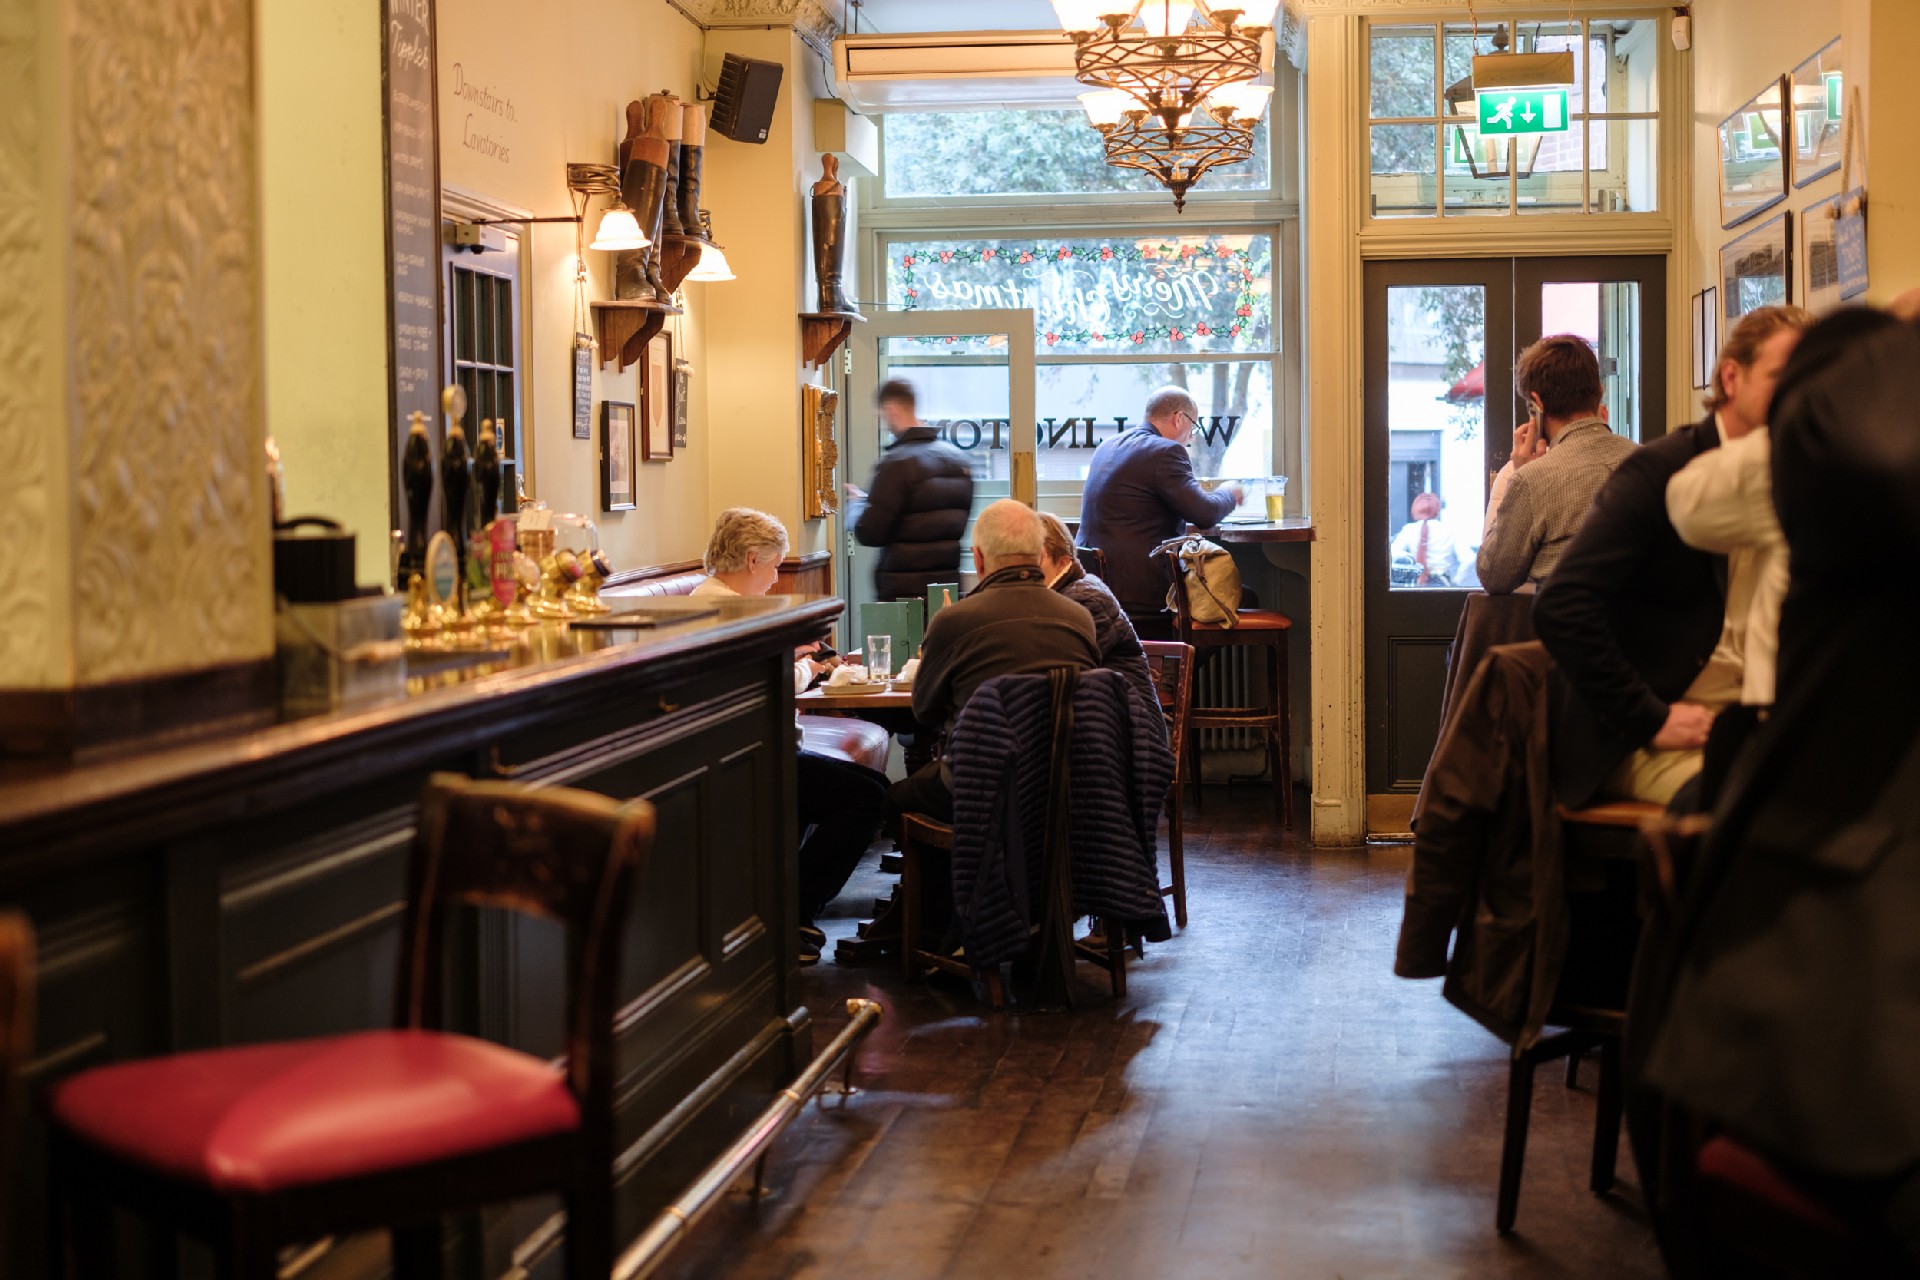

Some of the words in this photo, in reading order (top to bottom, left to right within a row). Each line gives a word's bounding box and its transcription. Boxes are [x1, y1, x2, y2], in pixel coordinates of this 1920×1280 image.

[390, 19, 429, 71] Tipples
[453, 62, 503, 117] Downstairs
[462, 112, 510, 164] Lavatories
